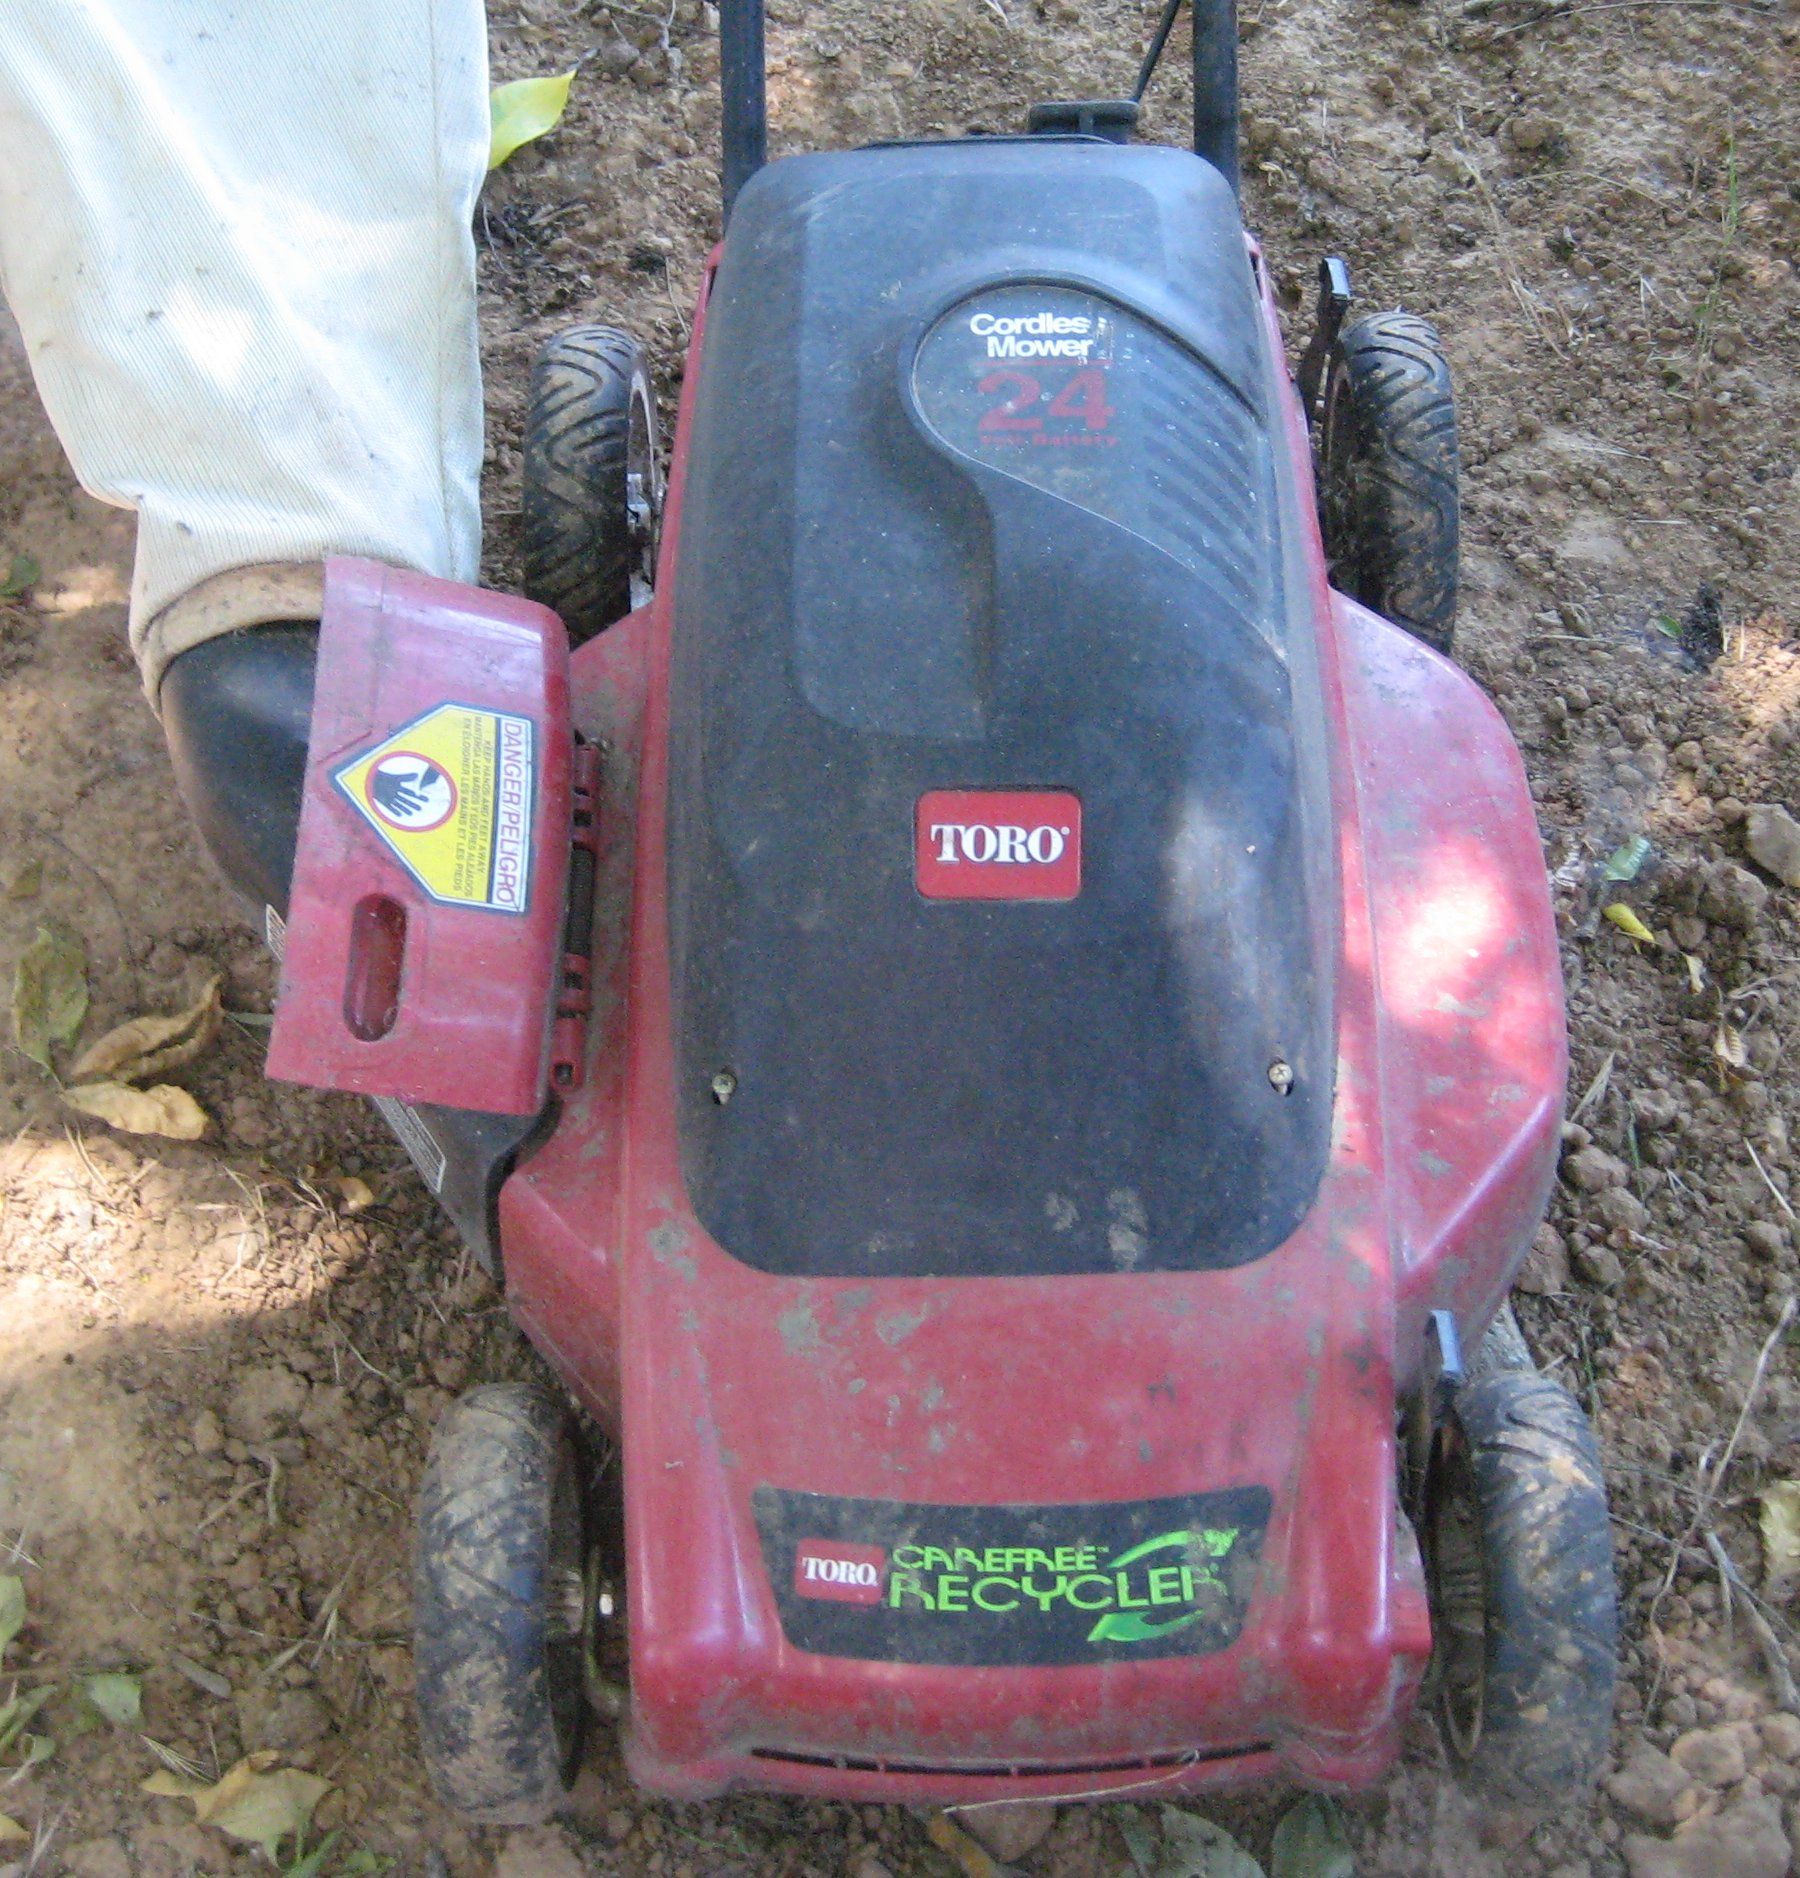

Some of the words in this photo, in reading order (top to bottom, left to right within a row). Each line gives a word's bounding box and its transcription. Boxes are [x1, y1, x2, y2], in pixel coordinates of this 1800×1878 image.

[987, 335, 1094, 358] Mower
[978, 370, 1118, 430] 24
[483, 740, 492, 764] KEEP
[472, 759, 482, 775] LAS
[482, 765, 491, 795] HANDS
[460, 776, 470, 795] LES
[458, 796, 469, 825] MAINS
[481, 797, 490, 817] AND
[496, 722, 522, 904] DANGER/PELIGRO
[469, 814, 478, 830] LOS
[479, 819, 489, 842] FEET
[456, 842, 465, 860] LES
[468, 832, 477, 850] PIES
[931, 824, 1064, 863] TORO
[453, 863, 464, 891] PIEDS
[802, 1556, 878, 1586] TORO
[893, 1544, 1097, 1572] CAREFREE
[889, 1565, 1228, 1612] RECYCLER
